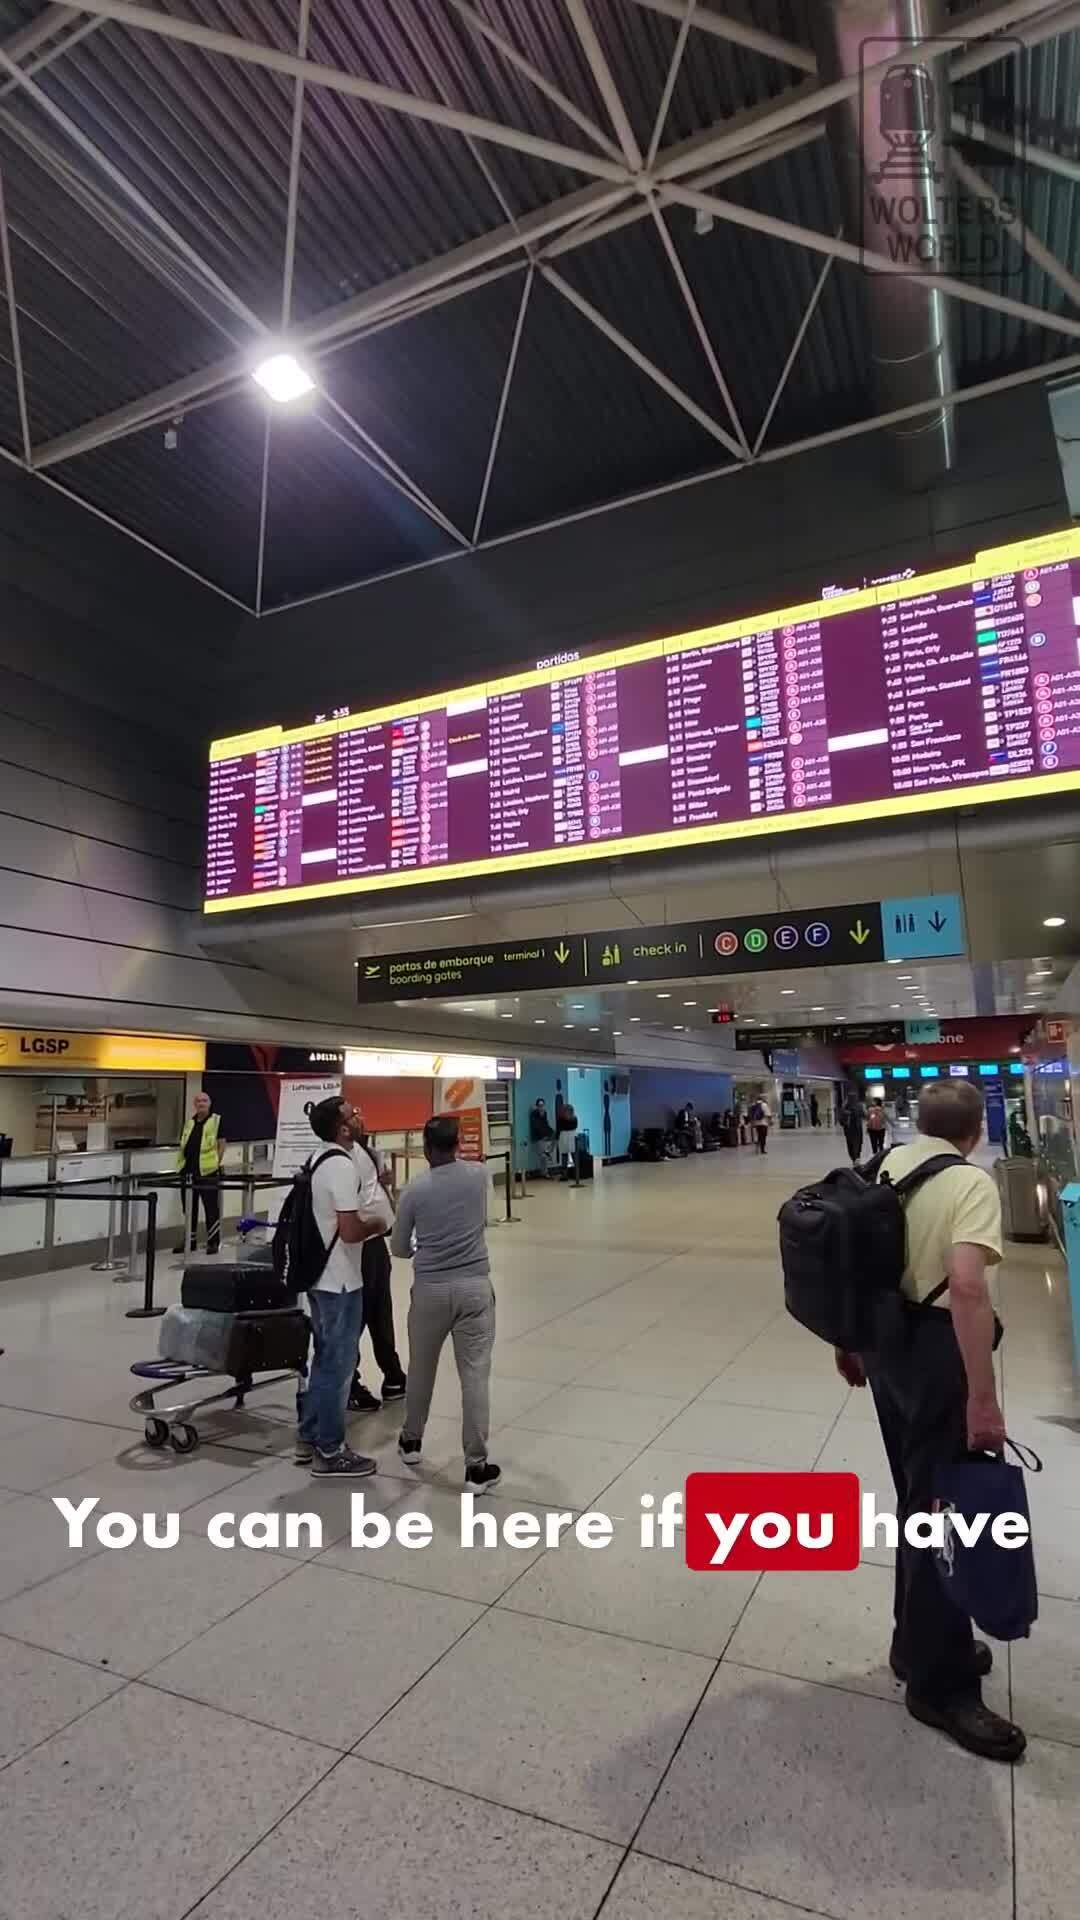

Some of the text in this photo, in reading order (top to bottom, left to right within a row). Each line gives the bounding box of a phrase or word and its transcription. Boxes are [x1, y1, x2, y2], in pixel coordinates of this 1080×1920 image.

[536, 652, 579, 669] partidas
[503, 951, 540, 961] terminal
[632, 942, 687, 957] check in
[389, 954, 494, 975] portas de embarque
[389, 969, 462, 985] boarding gates
[20, 1036, 70, 1054] LGSP
[938, 1034, 965, 1044] one
